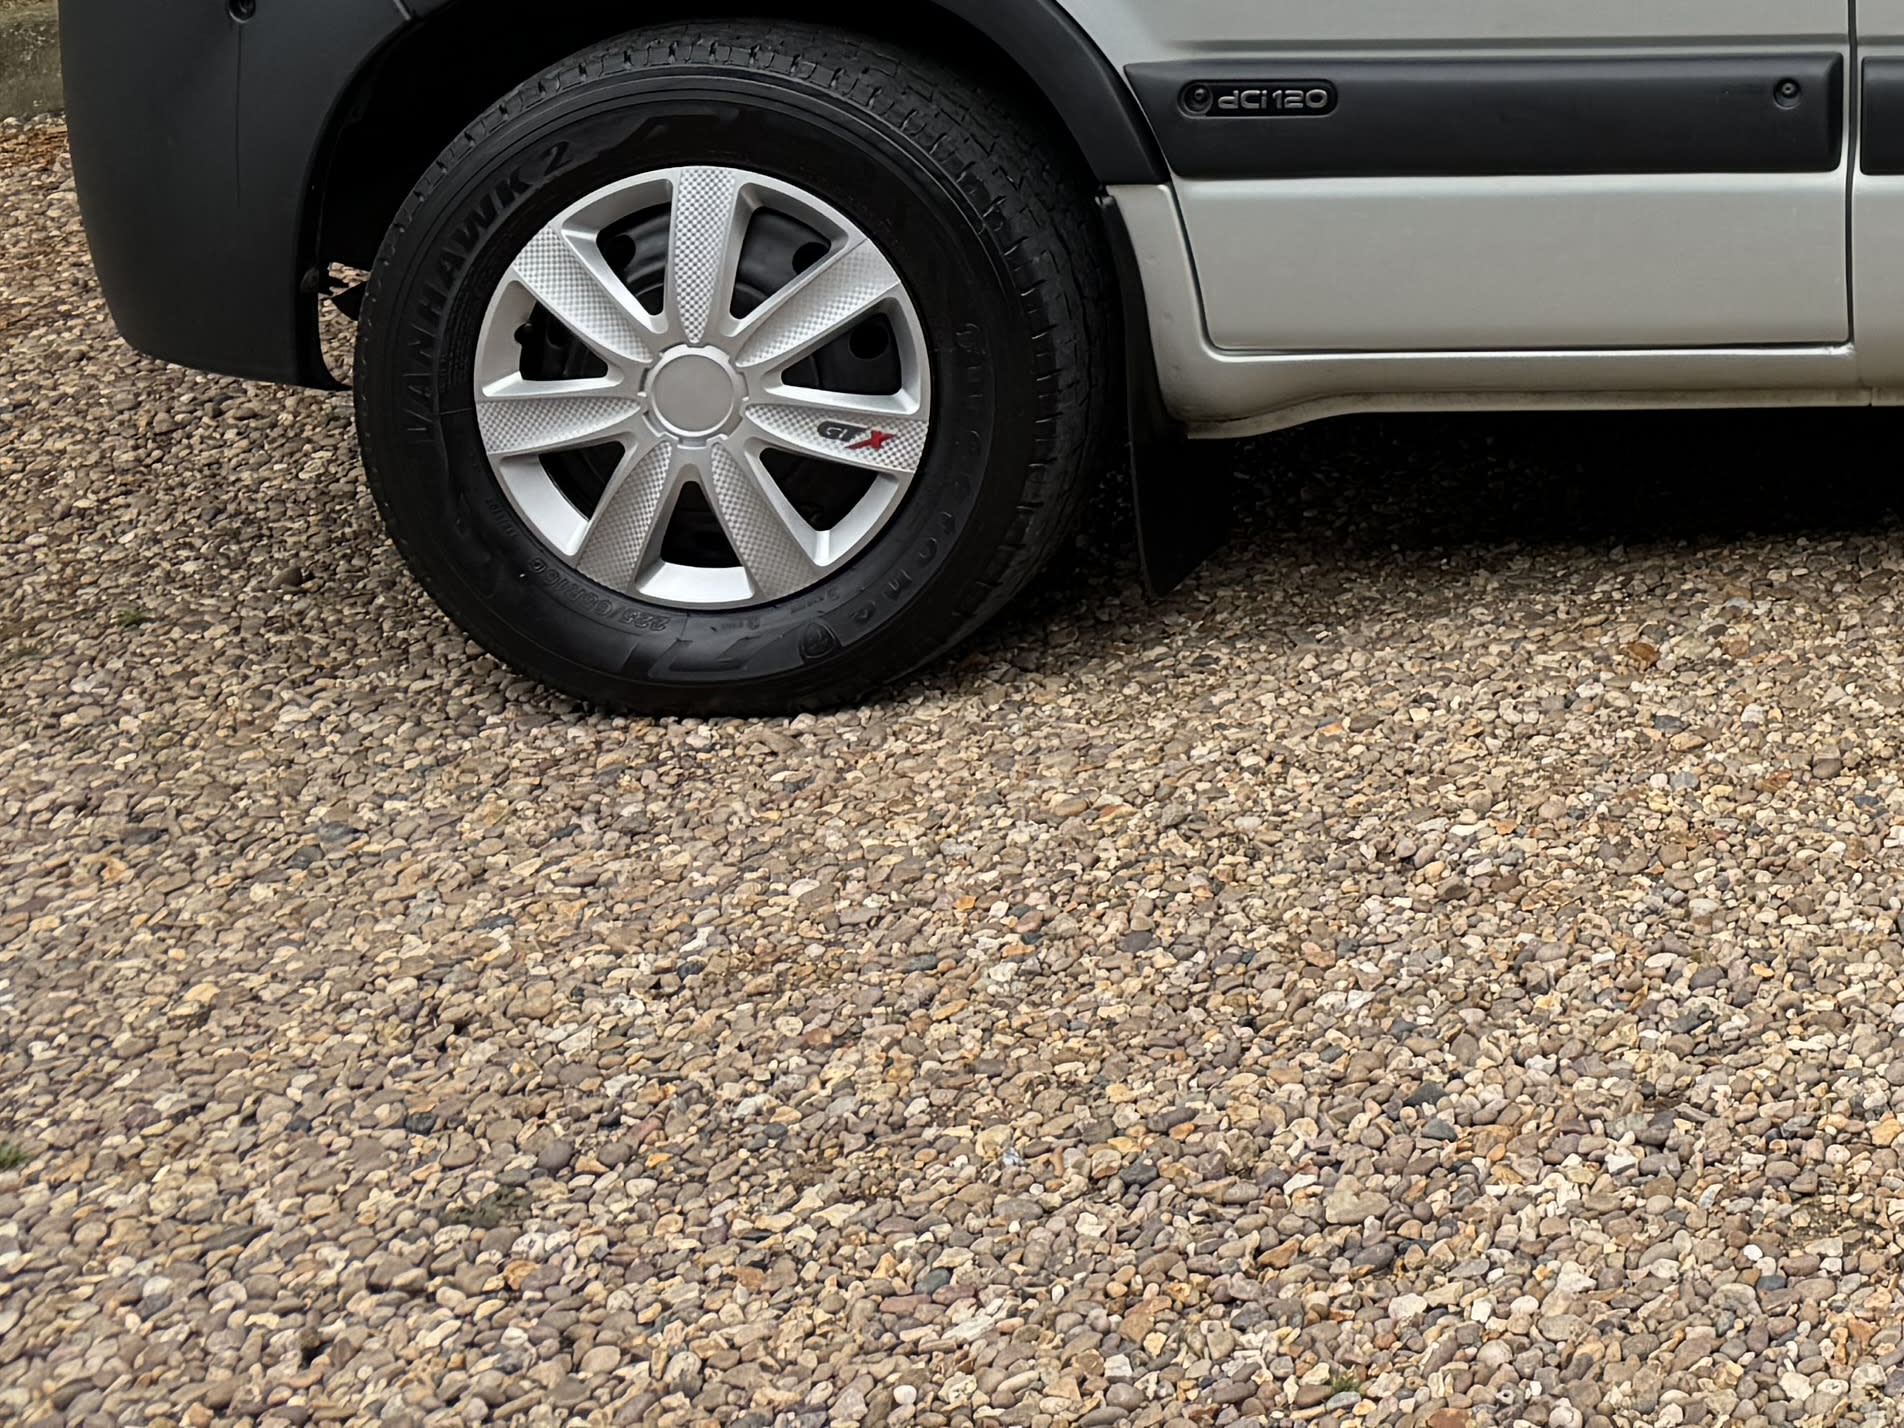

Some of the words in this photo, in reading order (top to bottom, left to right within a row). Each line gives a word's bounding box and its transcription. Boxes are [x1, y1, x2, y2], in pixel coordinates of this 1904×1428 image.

[1217, 89, 1268, 110] dCi
[1272, 88, 1328, 110] 120
[817, 420, 897, 451] GTX
